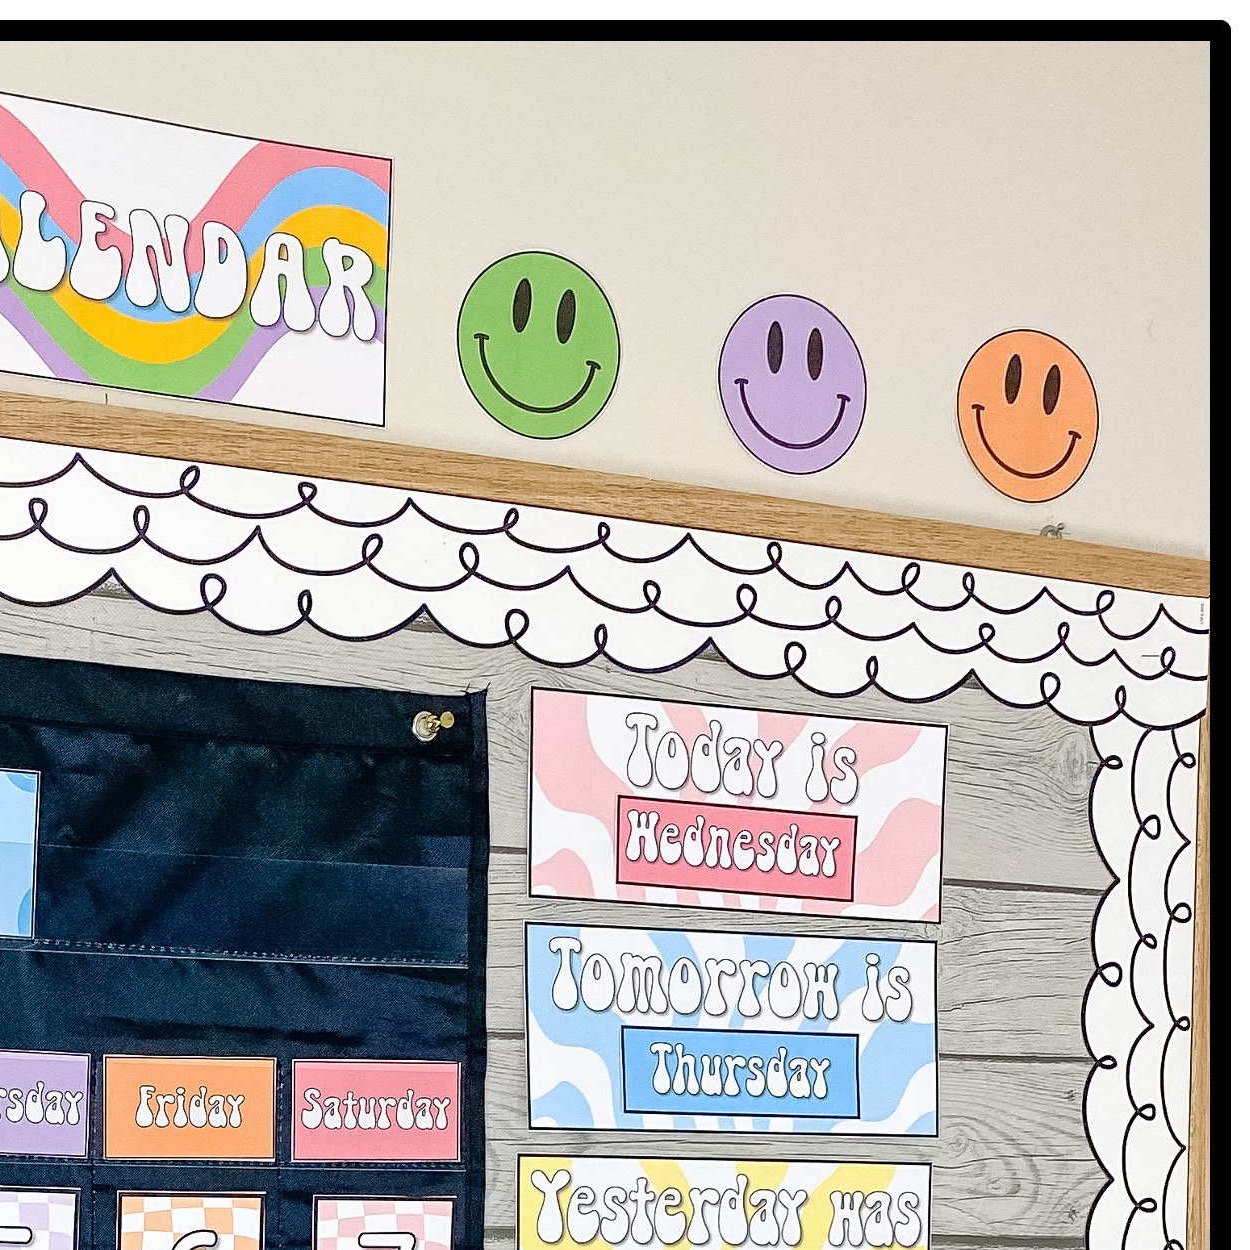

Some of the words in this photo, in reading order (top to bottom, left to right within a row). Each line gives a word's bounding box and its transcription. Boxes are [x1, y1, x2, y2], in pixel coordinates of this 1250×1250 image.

[625, 711, 784, 800] Today
[804, 731, 859, 804] is
[626, 810, 841, 878] Wednesday
[549, 937, 840, 1022] Tomorrow
[860, 953, 913, 1023] is
[650, 1041, 830, 1099] Thursday
[134, 1085, 245, 1131] Friday
[300, 1087, 451, 1131] Saturday
[530, 1169, 809, 1246] Yesterday
[828, 1188, 922, 1249] was
